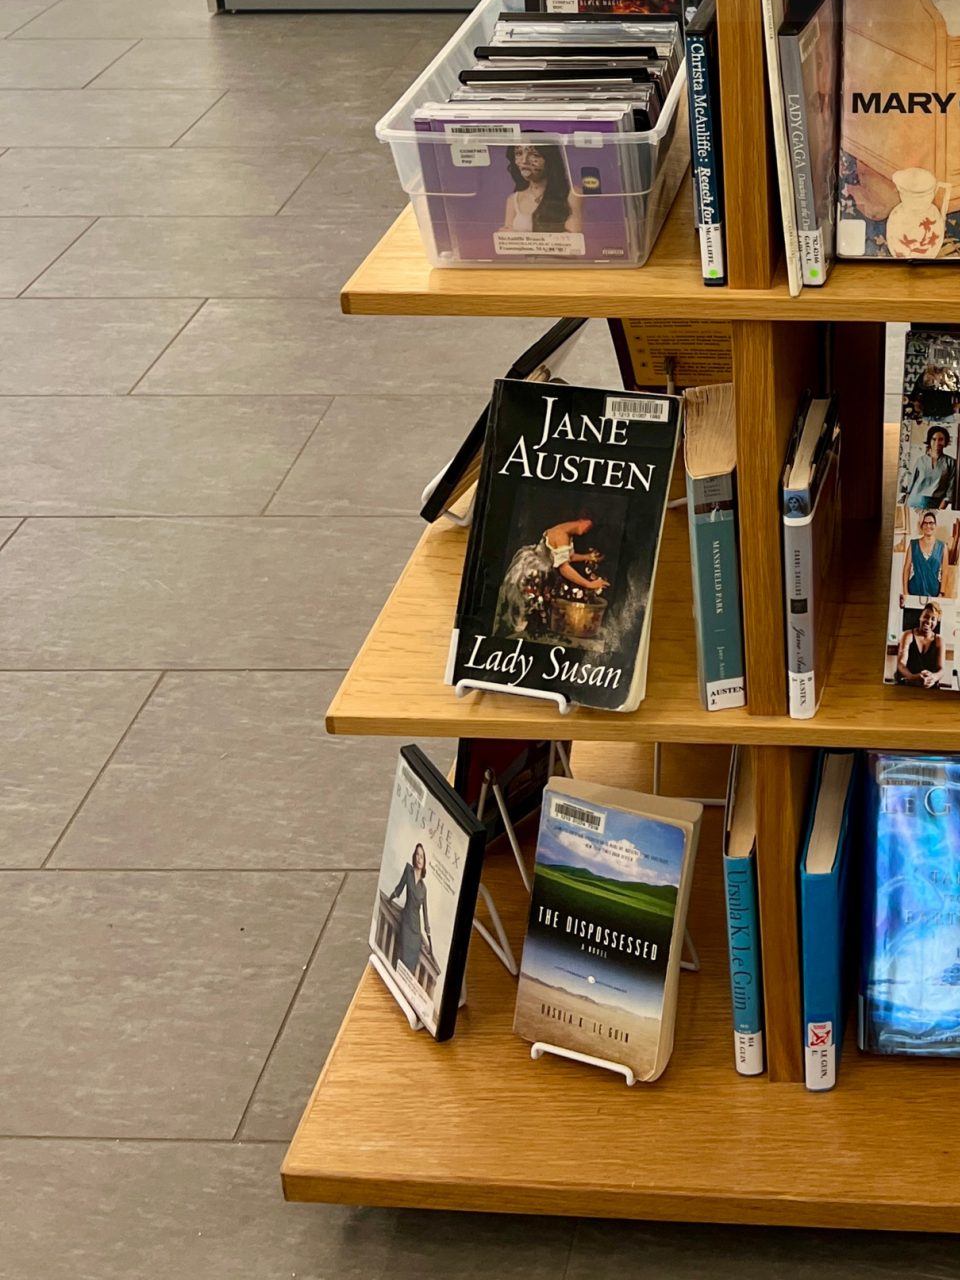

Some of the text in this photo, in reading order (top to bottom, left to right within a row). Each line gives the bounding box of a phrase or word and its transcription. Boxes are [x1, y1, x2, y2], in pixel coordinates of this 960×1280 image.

[690, 42, 714, 208] Christa McAuliffe: Reach
[851, 92, 954, 114] MARY
[788, 94, 806, 169] LADY GAGA
[533, 396, 630, 449] JANE
[498, 435, 656, 493] AUSTEN
[712, 540, 724, 614] MANSFIELD PARK
[464, 635, 622, 691] Lady Susan
[710, 685, 745, 697] AUSTEN
[539, 906, 657, 961] THE DISPOSSESSED
